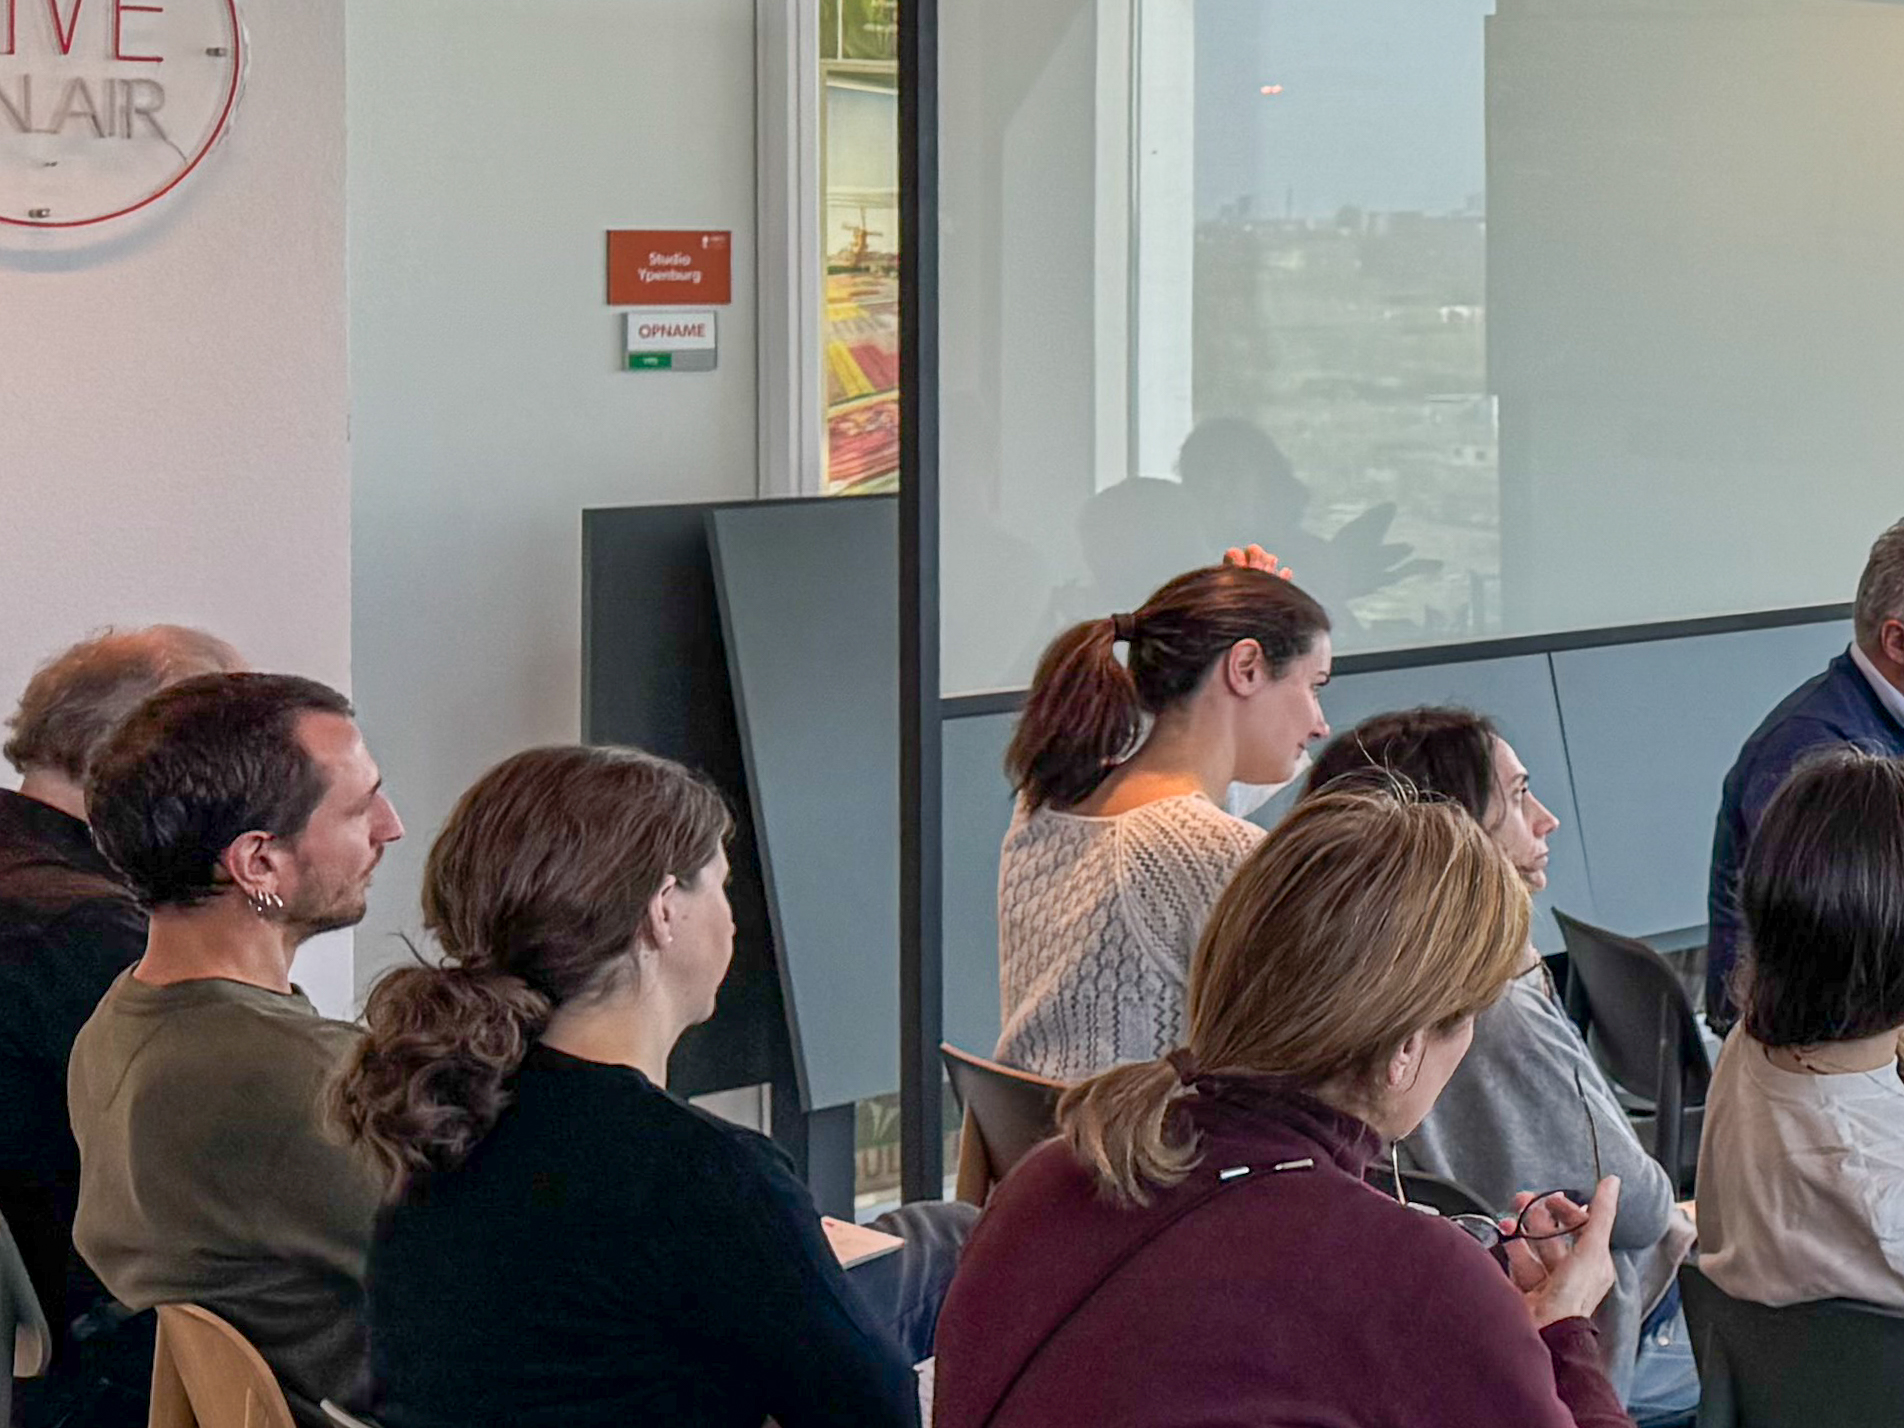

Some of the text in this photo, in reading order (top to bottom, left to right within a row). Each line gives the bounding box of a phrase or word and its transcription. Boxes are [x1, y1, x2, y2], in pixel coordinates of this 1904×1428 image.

[52, 76, 166, 140] AIR
[648, 251, 692, 267] Studio
[638, 323, 706, 339] OPNAME
